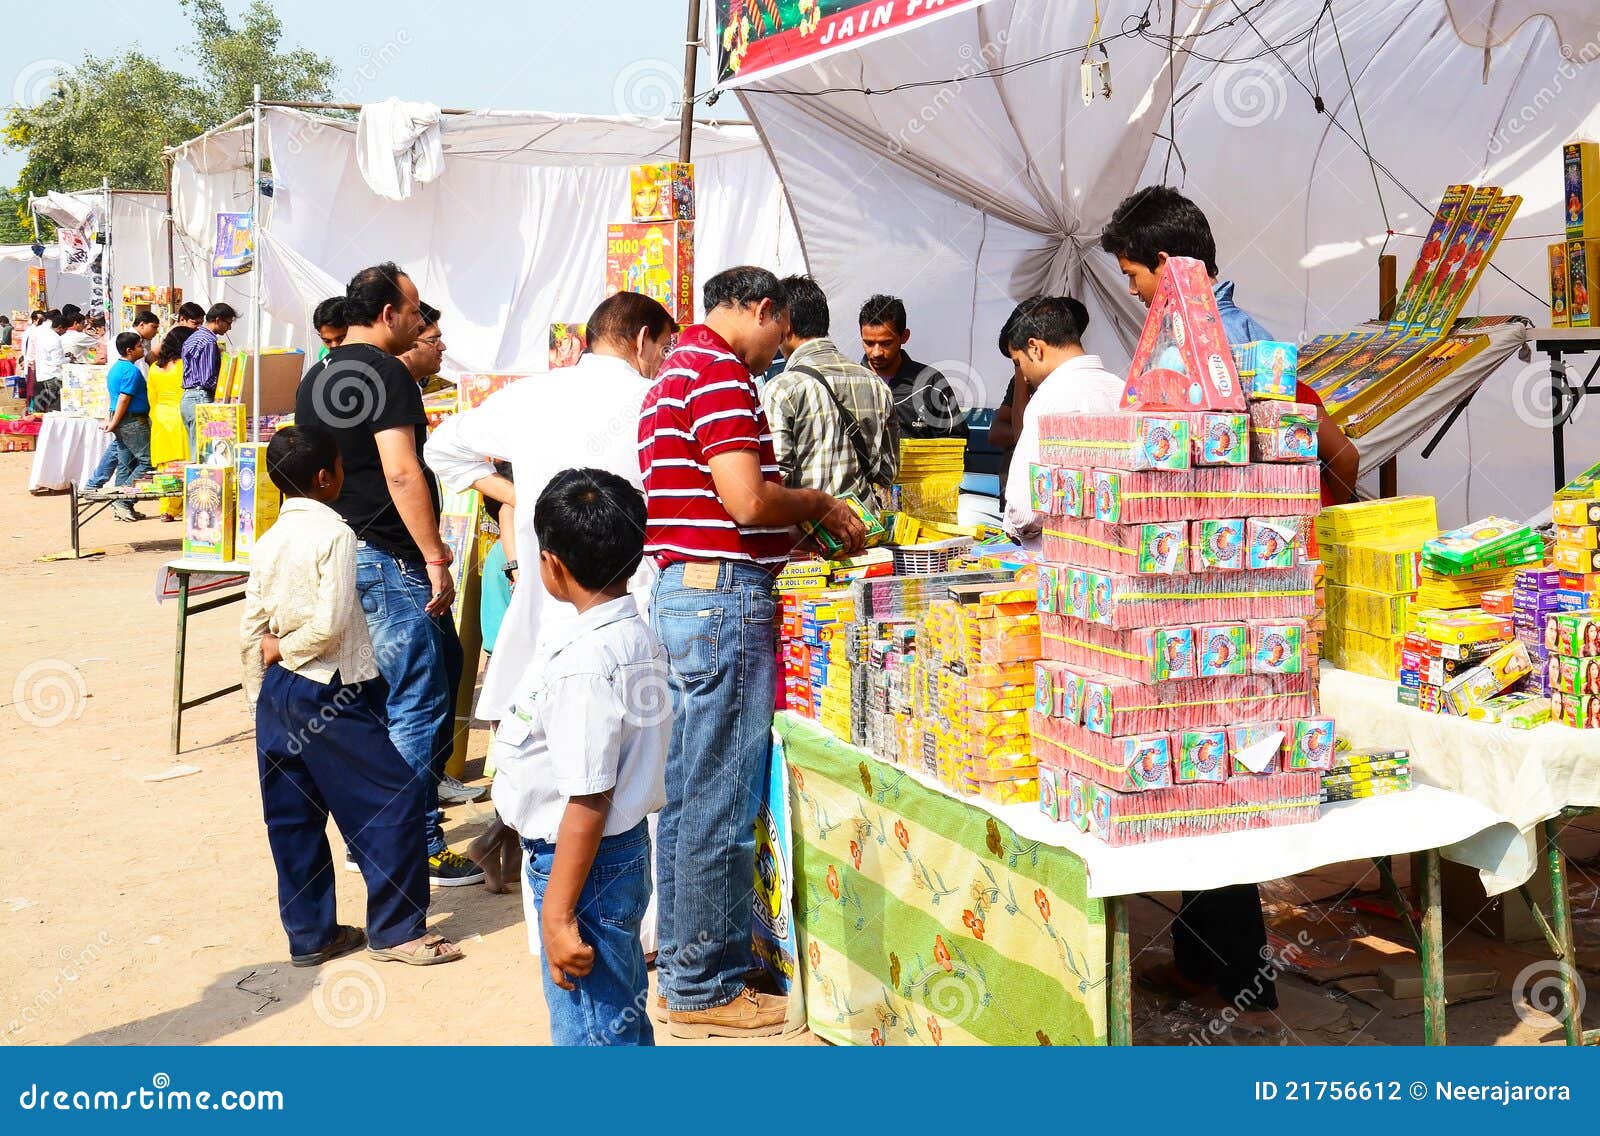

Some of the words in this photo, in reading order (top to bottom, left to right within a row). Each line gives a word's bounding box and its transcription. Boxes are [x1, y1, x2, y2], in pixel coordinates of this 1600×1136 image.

[820, 1, 895, 45] JAIN
[608, 239, 639, 255] 5000
[681, 274, 690, 306] 5000
[1211, 355, 1231, 394] TOWER
